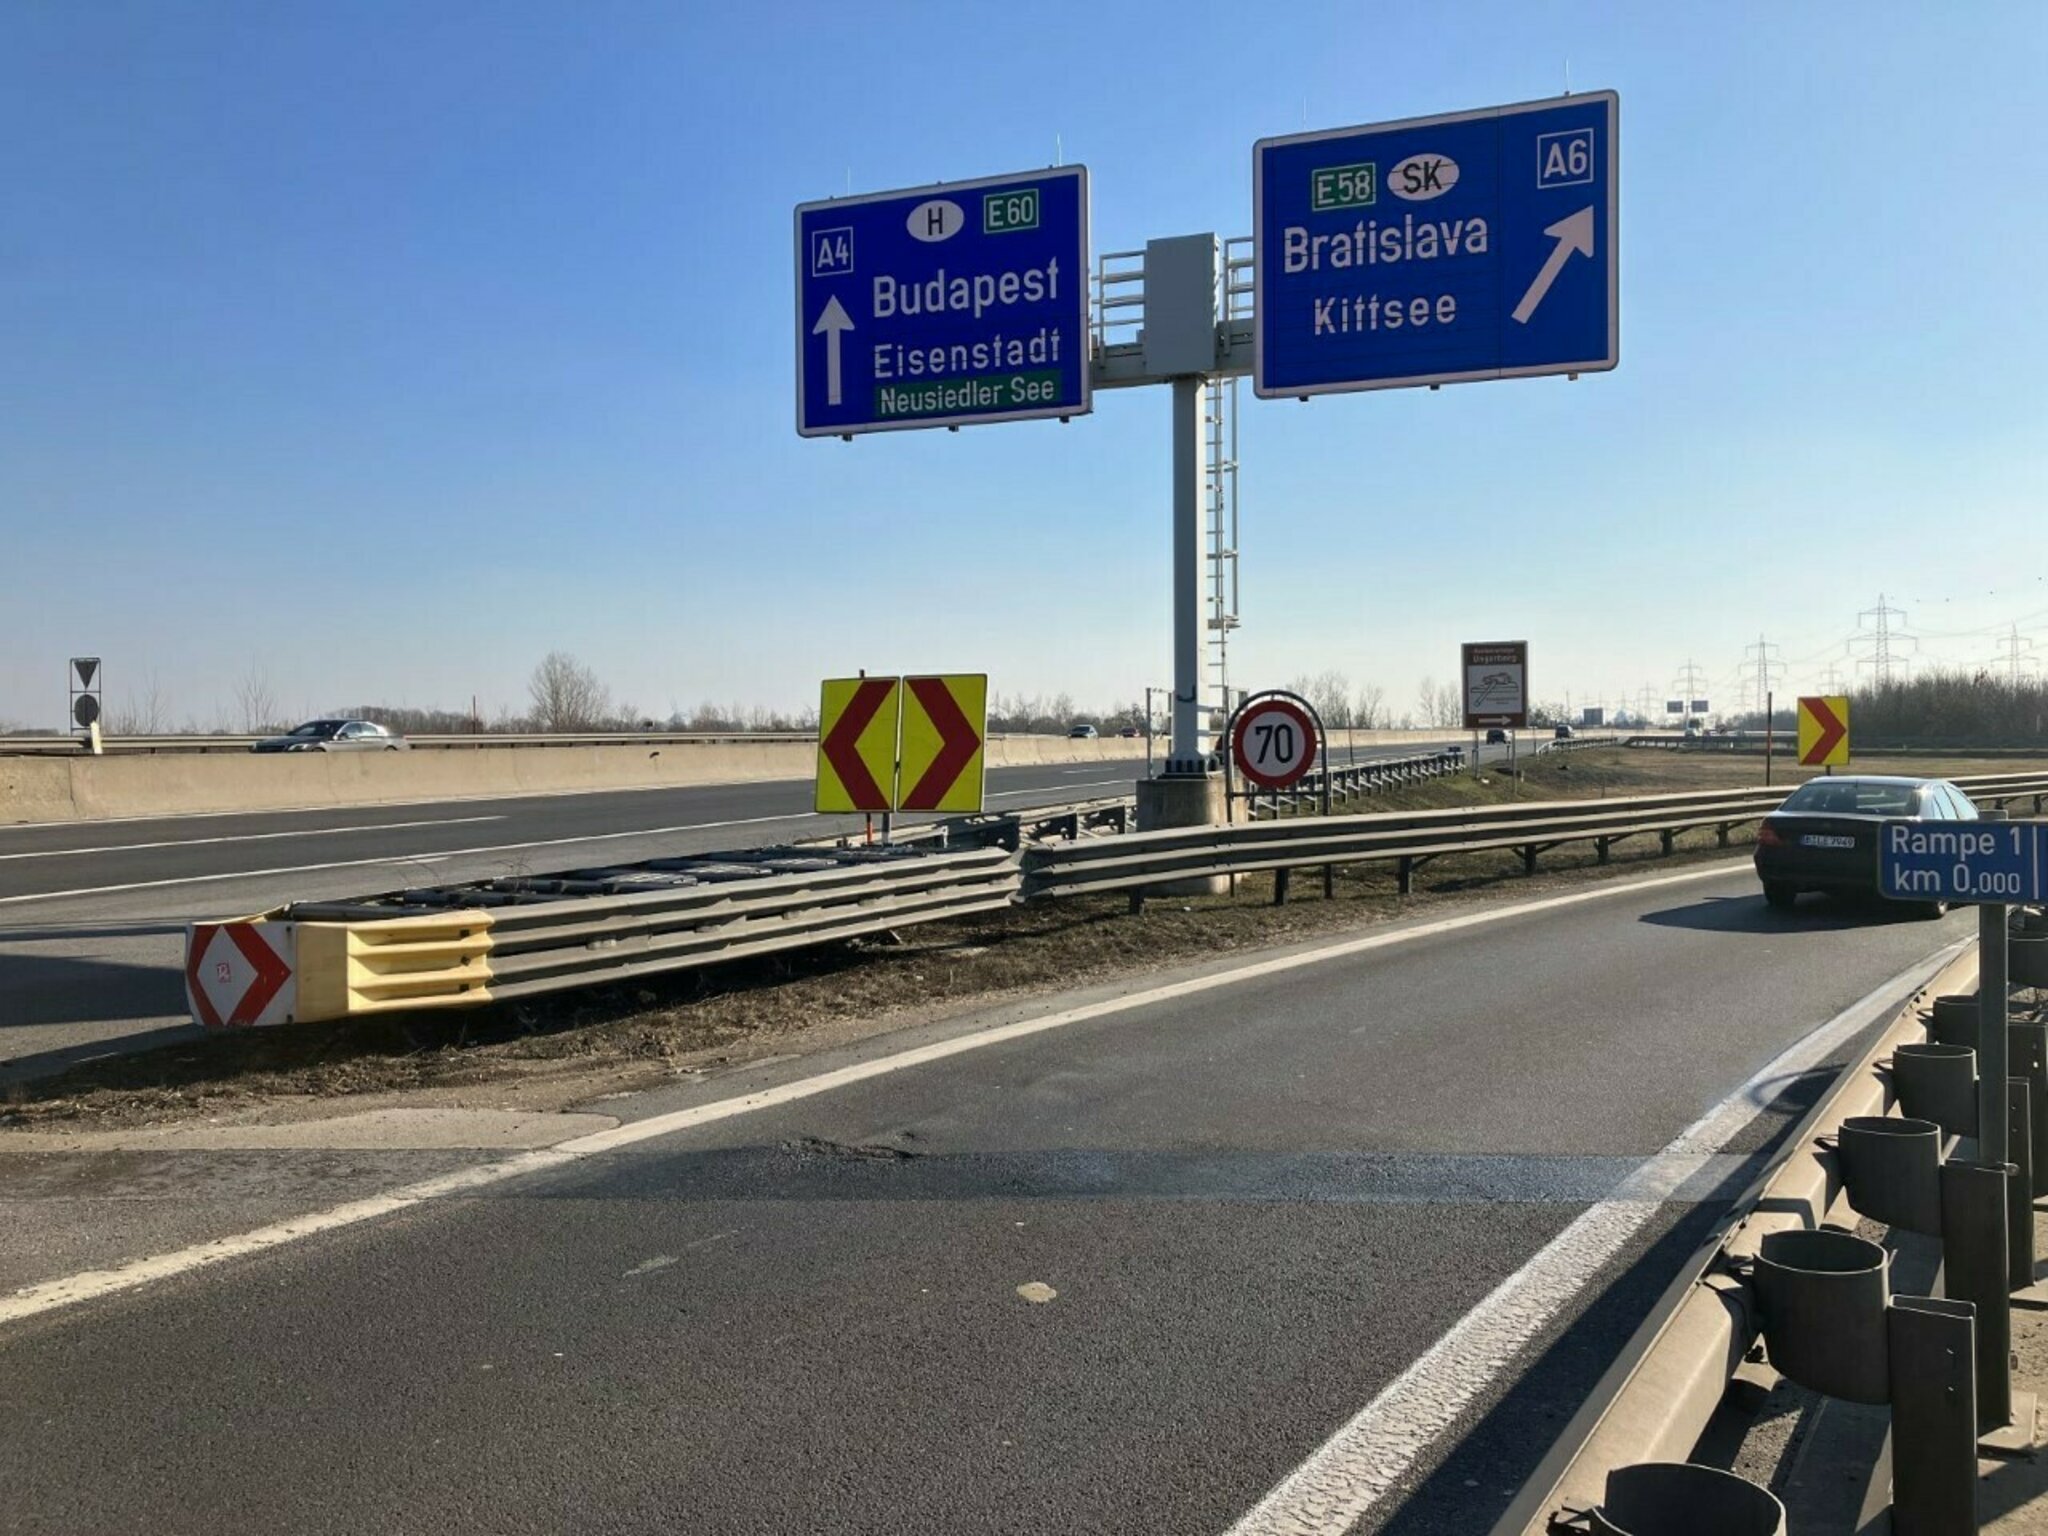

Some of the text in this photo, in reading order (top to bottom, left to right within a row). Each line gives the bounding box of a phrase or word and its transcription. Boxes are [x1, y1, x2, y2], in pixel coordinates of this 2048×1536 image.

[1402, 159, 1443, 194] SK
[1543, 139, 1588, 179] A6
[927, 206, 943, 236] H
[817, 236, 849, 268] A4
[1284, 213, 1488, 273] Bratislava
[873, 256, 1059, 319] Budapest
[1314, 294, 1457, 336] Kittsee
[874, 327, 1060, 379] Eisenstadt
[881, 377, 1055, 414] Neusiedler See
[1255, 723, 1293, 764] 70
[1891, 825, 1995, 861] Rampe
[2009, 826, 2022, 855] 1
[1894, 863, 2021, 895] km 0,000
